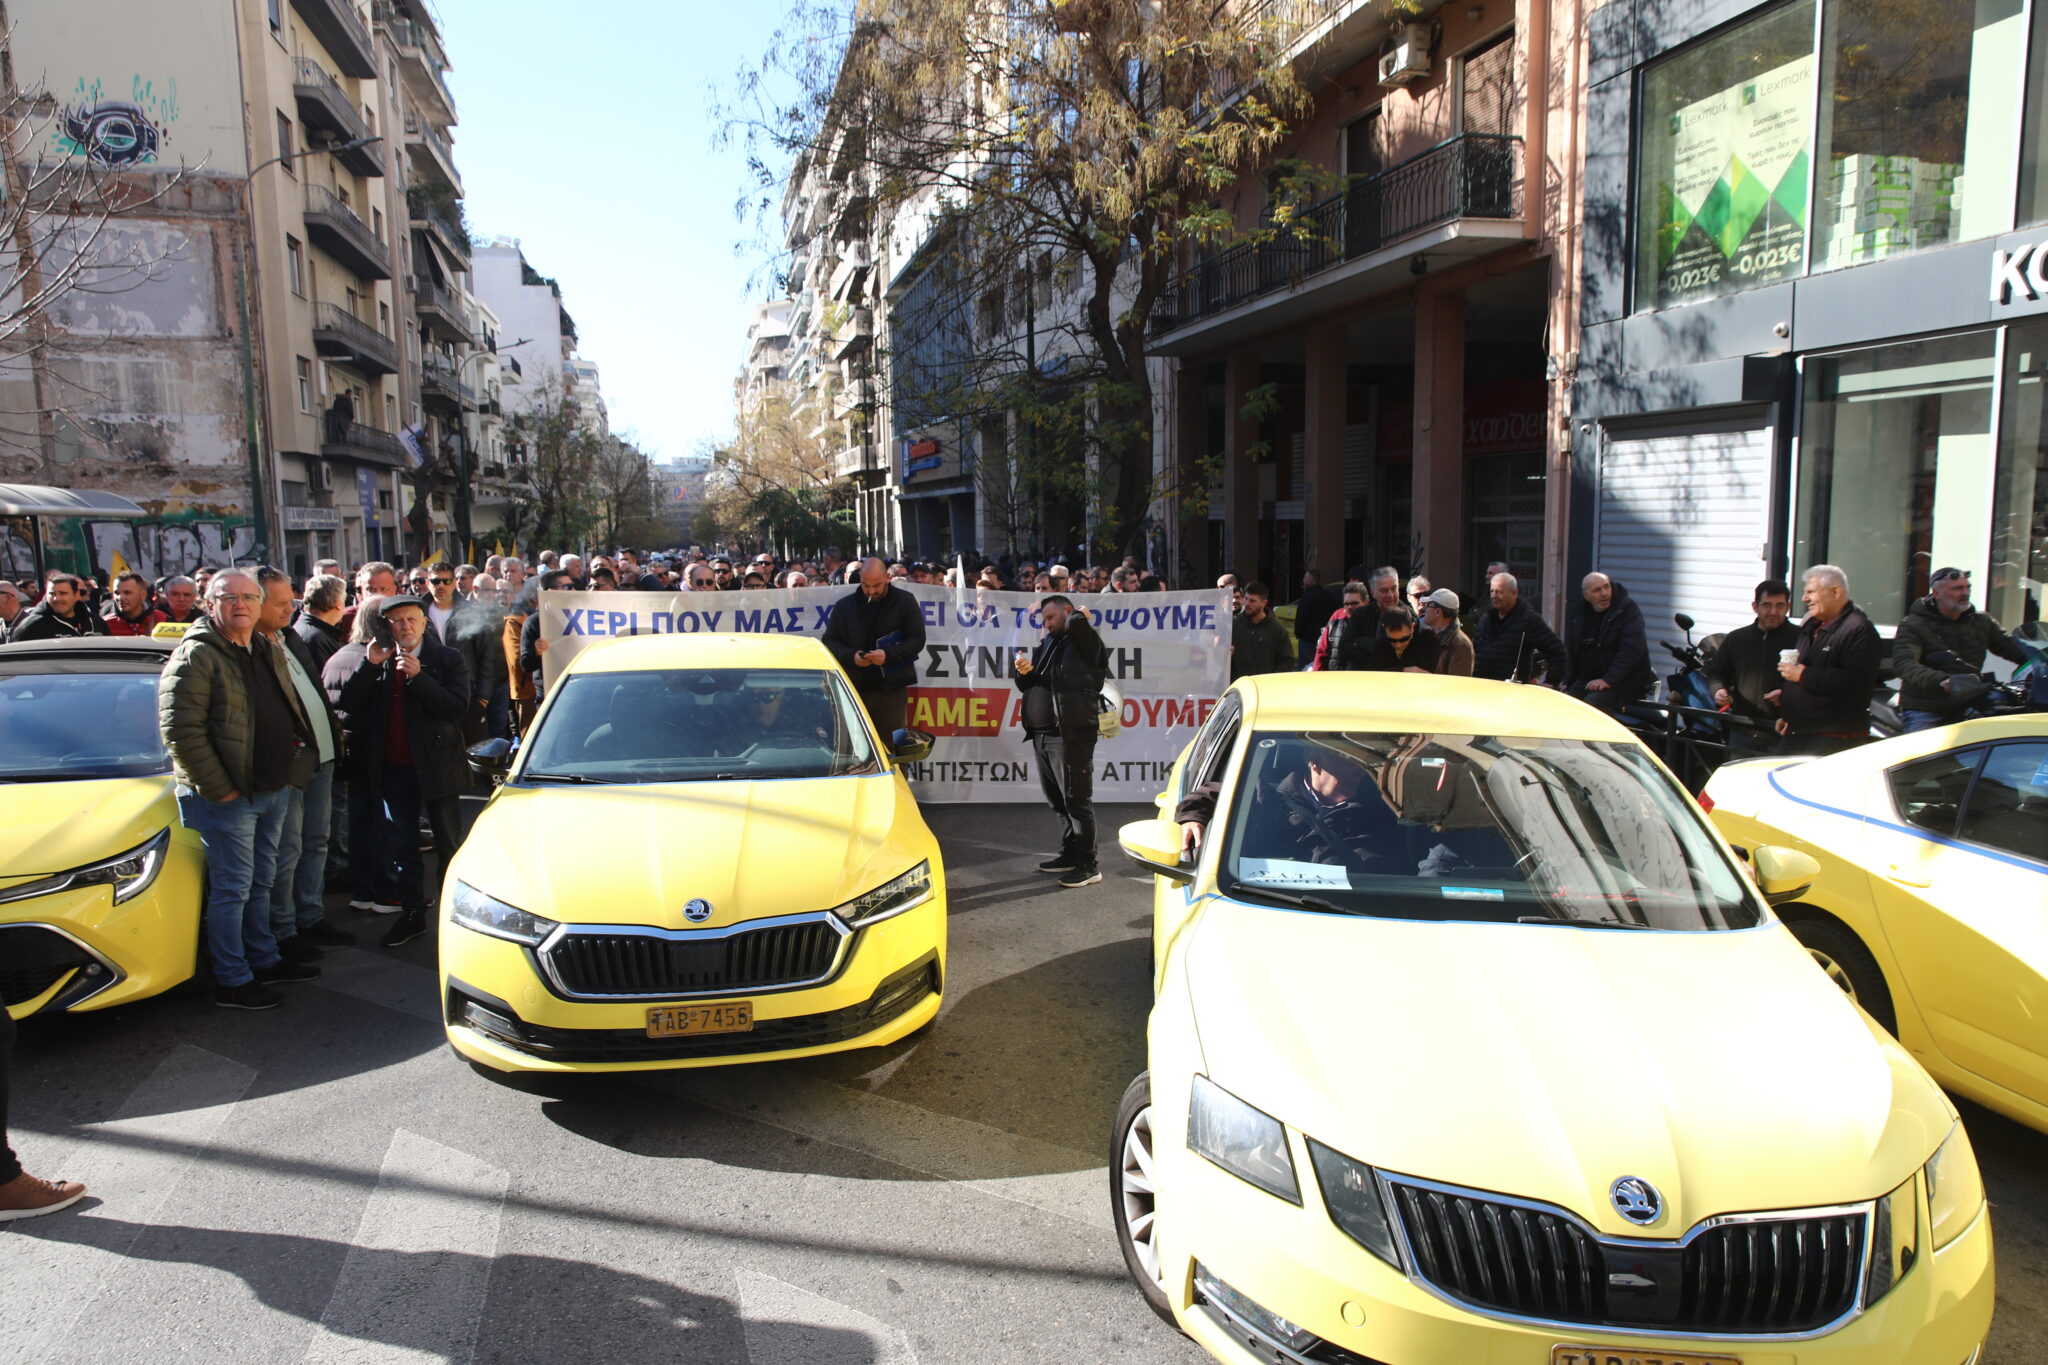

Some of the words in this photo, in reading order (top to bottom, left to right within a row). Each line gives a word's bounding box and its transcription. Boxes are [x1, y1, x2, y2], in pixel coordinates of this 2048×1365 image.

[1759, 66, 1811, 97] Lexmark
[1684, 99, 1729, 127] Lexmark
[1730, 242, 1802, 276] -0,023€
[1467, 411, 1548, 444] xande
[562, 609, 638, 636] ΧΕΡΙ
[652, 610, 722, 634] ΠΟΥ
[734, 607, 804, 633] ΜΑΣ
[957, 602, 1000, 628] ΘΑ
[1088, 604, 1216, 630] ΟΨΟΥΜΕ
[1101, 761, 1177, 781] ΑΤΤΙΚ
